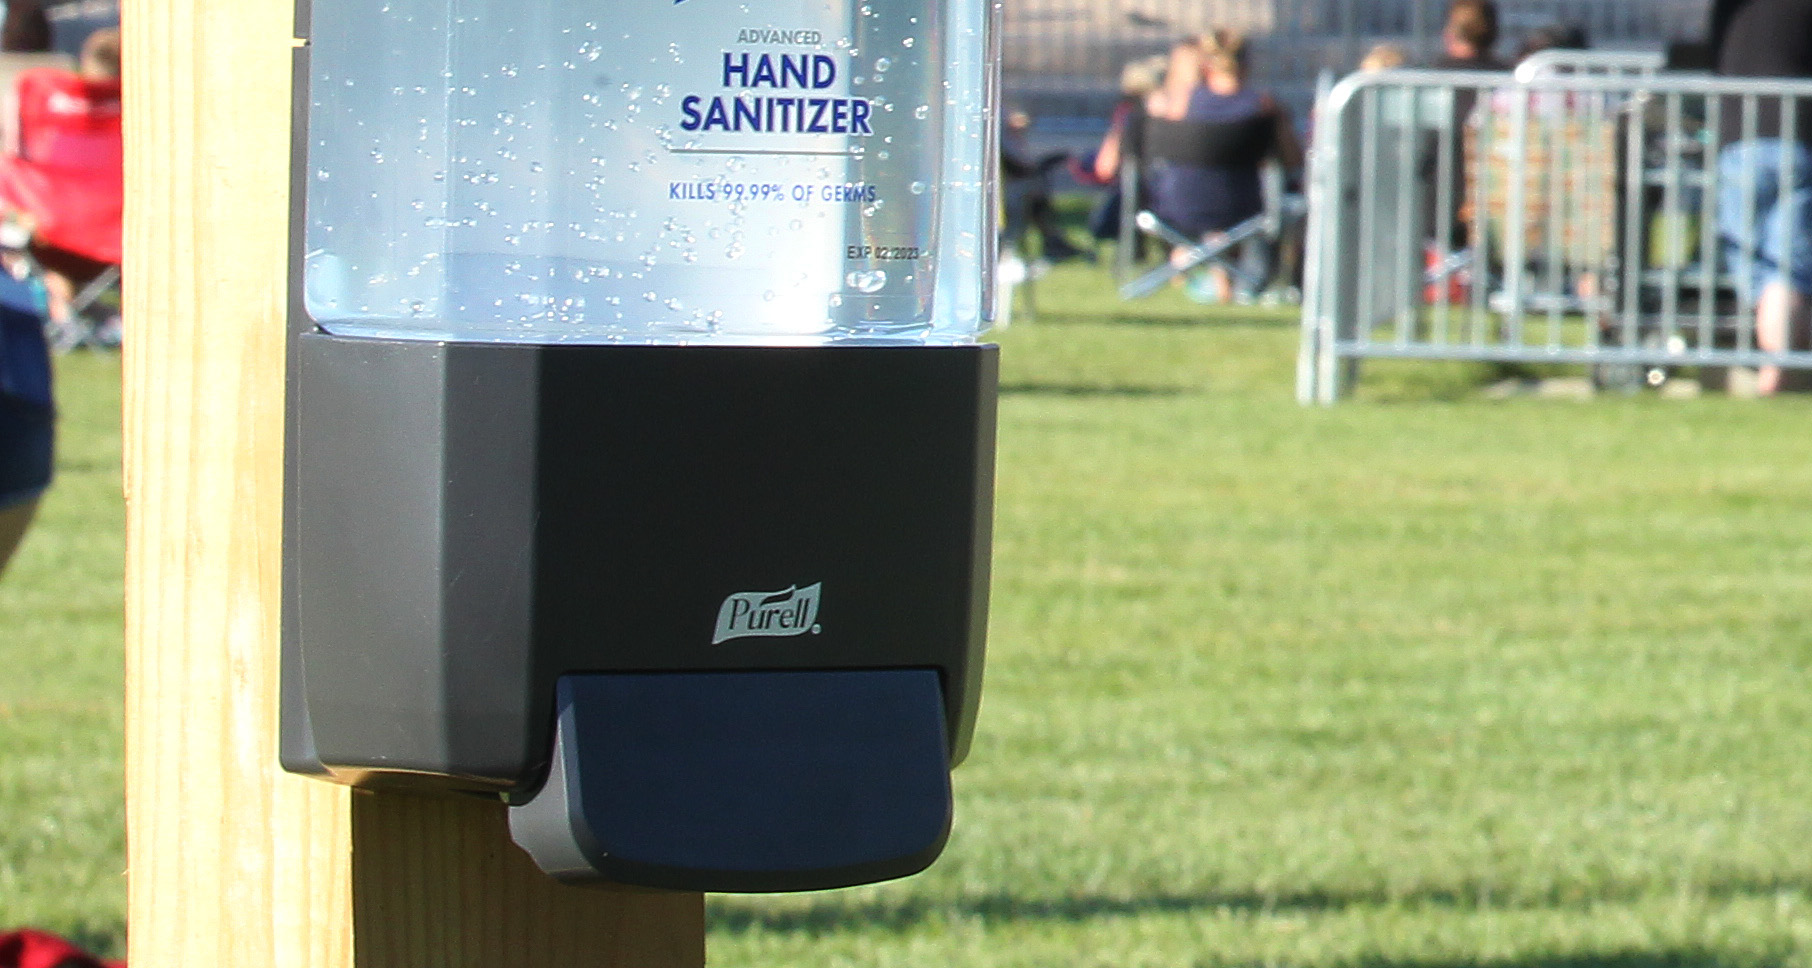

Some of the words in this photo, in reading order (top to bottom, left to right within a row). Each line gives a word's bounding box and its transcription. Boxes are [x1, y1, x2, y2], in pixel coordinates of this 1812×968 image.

[736, 29, 822, 45] ADVANCED
[722, 51, 837, 90] HAND
[680, 95, 873, 134] SANITIZER
[669, 182, 716, 200] KILLS
[723, 182, 785, 201] 99.99%
[791, 185, 814, 202] OF
[821, 185, 877, 203] GERMS
[847, 245, 872, 260] EXP
[728, 597, 811, 631] Purell
